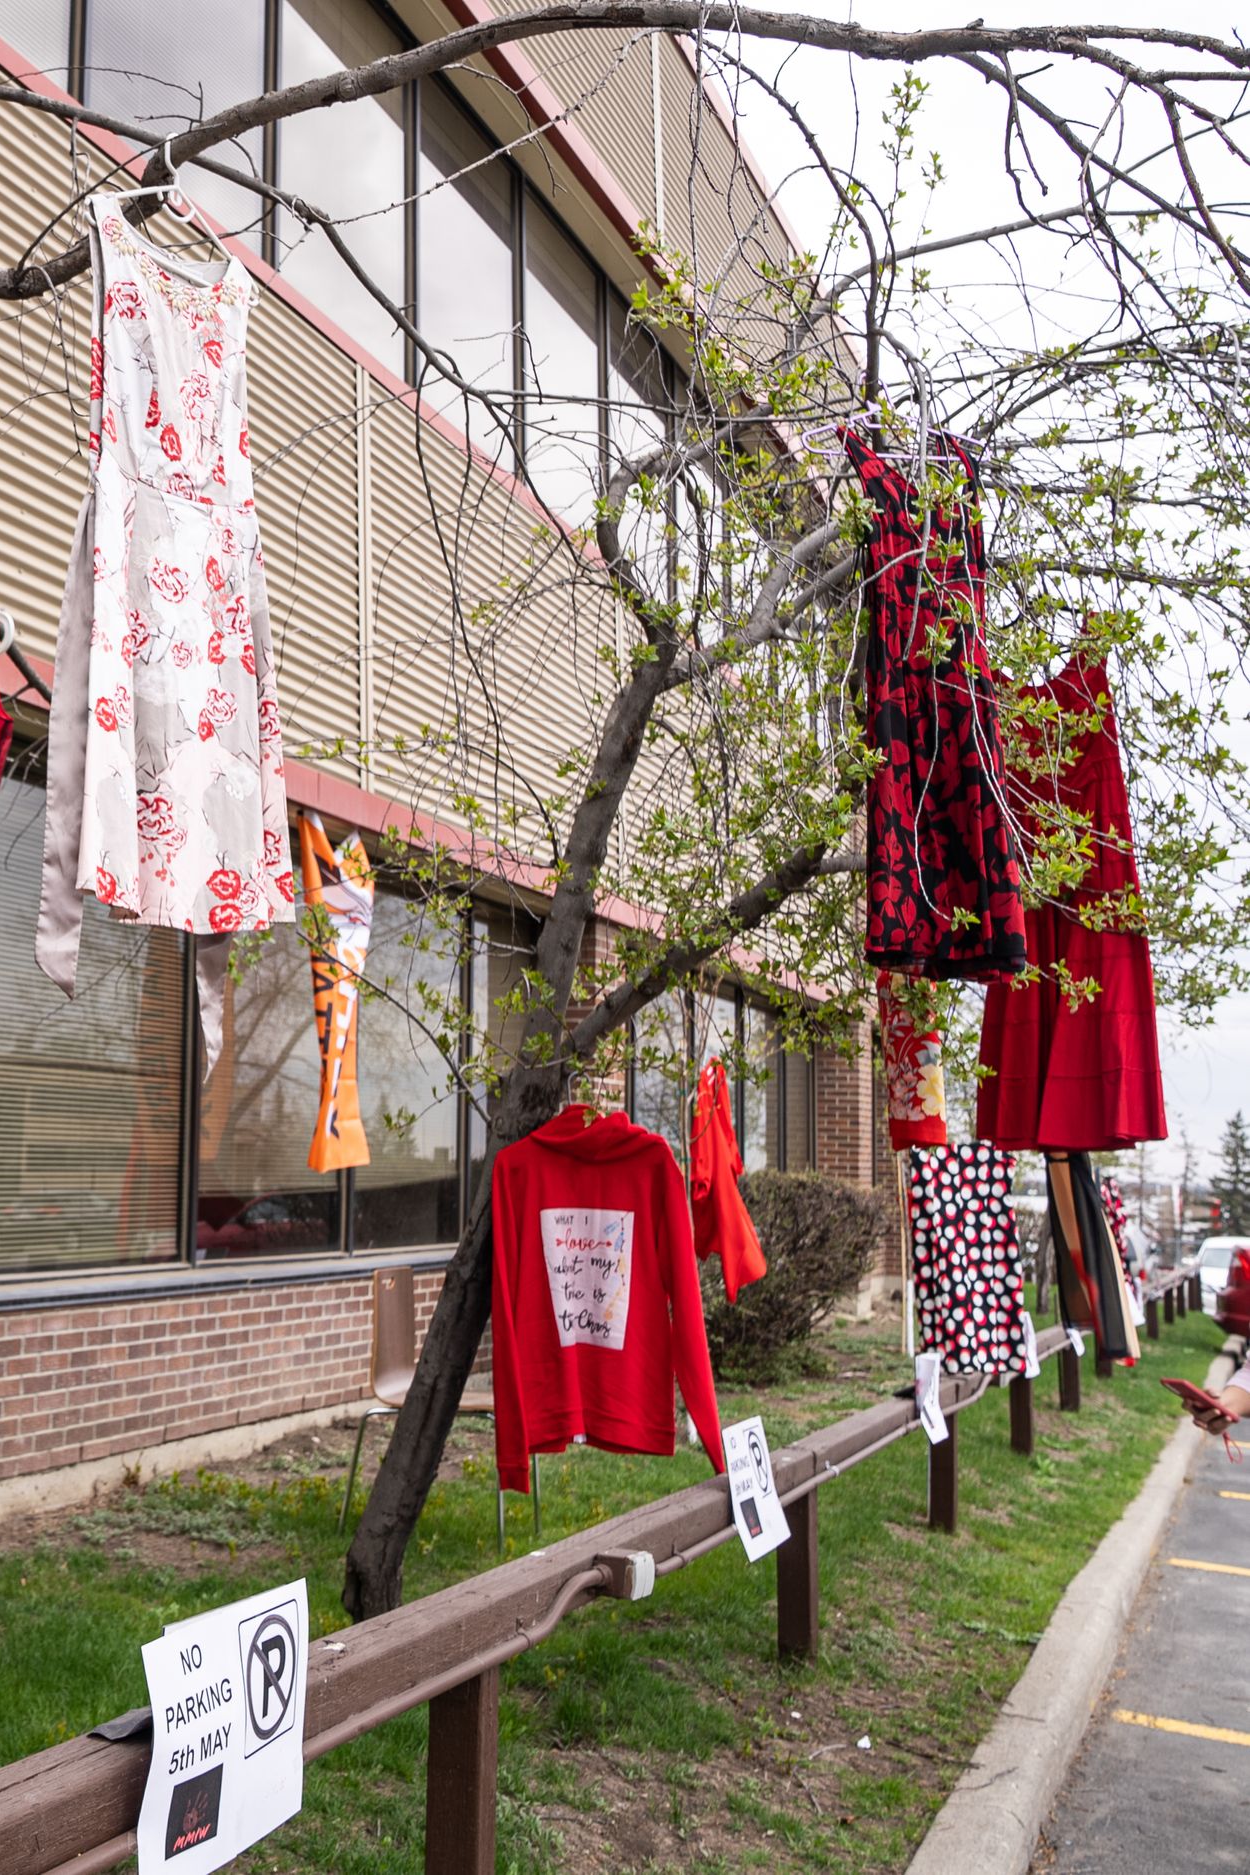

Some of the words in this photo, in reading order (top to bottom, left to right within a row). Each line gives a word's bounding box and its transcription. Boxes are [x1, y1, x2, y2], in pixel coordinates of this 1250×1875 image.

[554, 1215, 574, 1225] WHAT
[565, 1228, 602, 1252] love
[591, 1256, 614, 1280] my
[180, 1644, 202, 1675] NO
[166, 1678, 233, 1734] PARKING
[168, 1744, 194, 1775] 5th
[200, 1722, 232, 1762] MAY
[173, 1823, 211, 1852] MMIW
